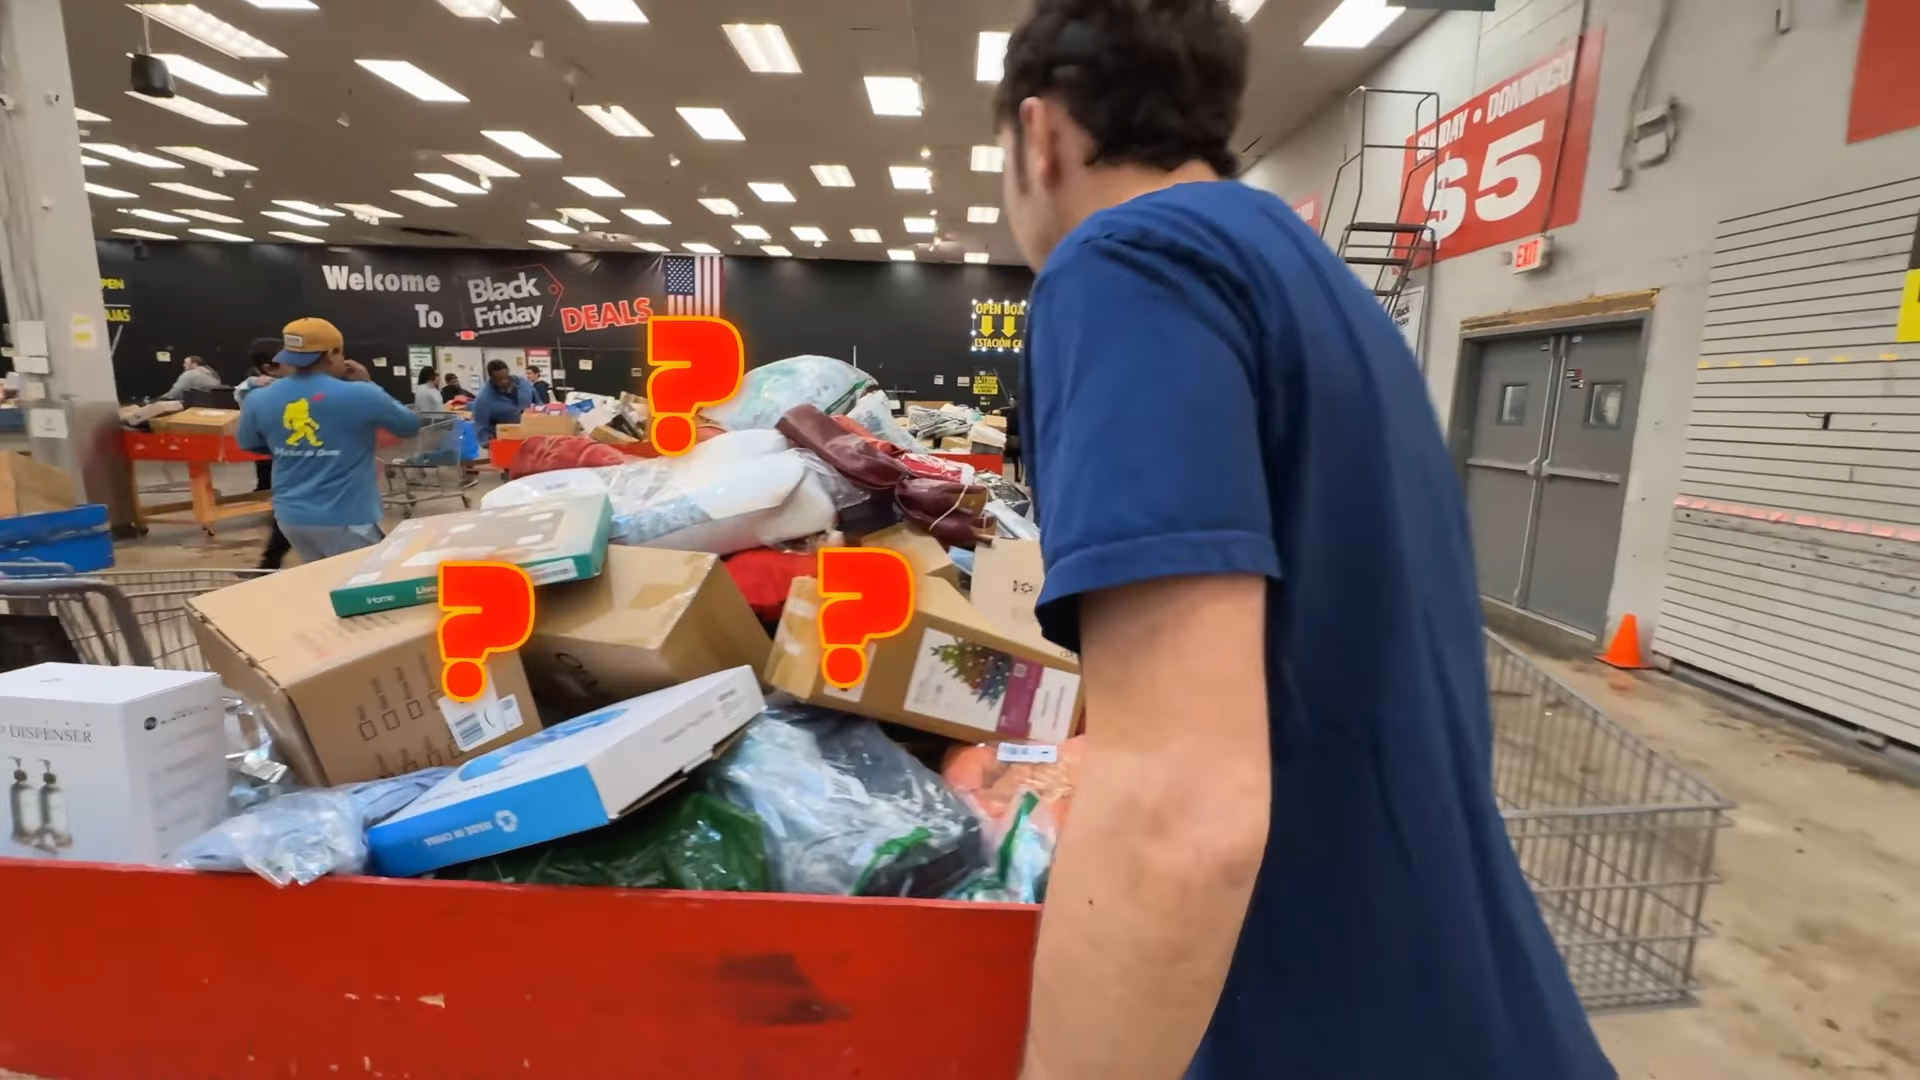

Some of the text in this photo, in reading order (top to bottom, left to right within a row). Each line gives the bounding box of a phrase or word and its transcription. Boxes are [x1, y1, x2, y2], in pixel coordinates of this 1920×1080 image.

[1420, 118, 1545, 250] $5
[1515, 239, 1541, 269] EXIT
[101, 278, 125, 290] PEN
[322, 264, 441, 293] Welcome
[467, 272, 541, 304] Black
[415, 303, 444, 329] To
[474, 302, 544, 329] Friday
[560, 297, 654, 334] DEALS
[975, 303, 1001, 315] OPEN
[9, 724, 92, 744] DISPENSER
